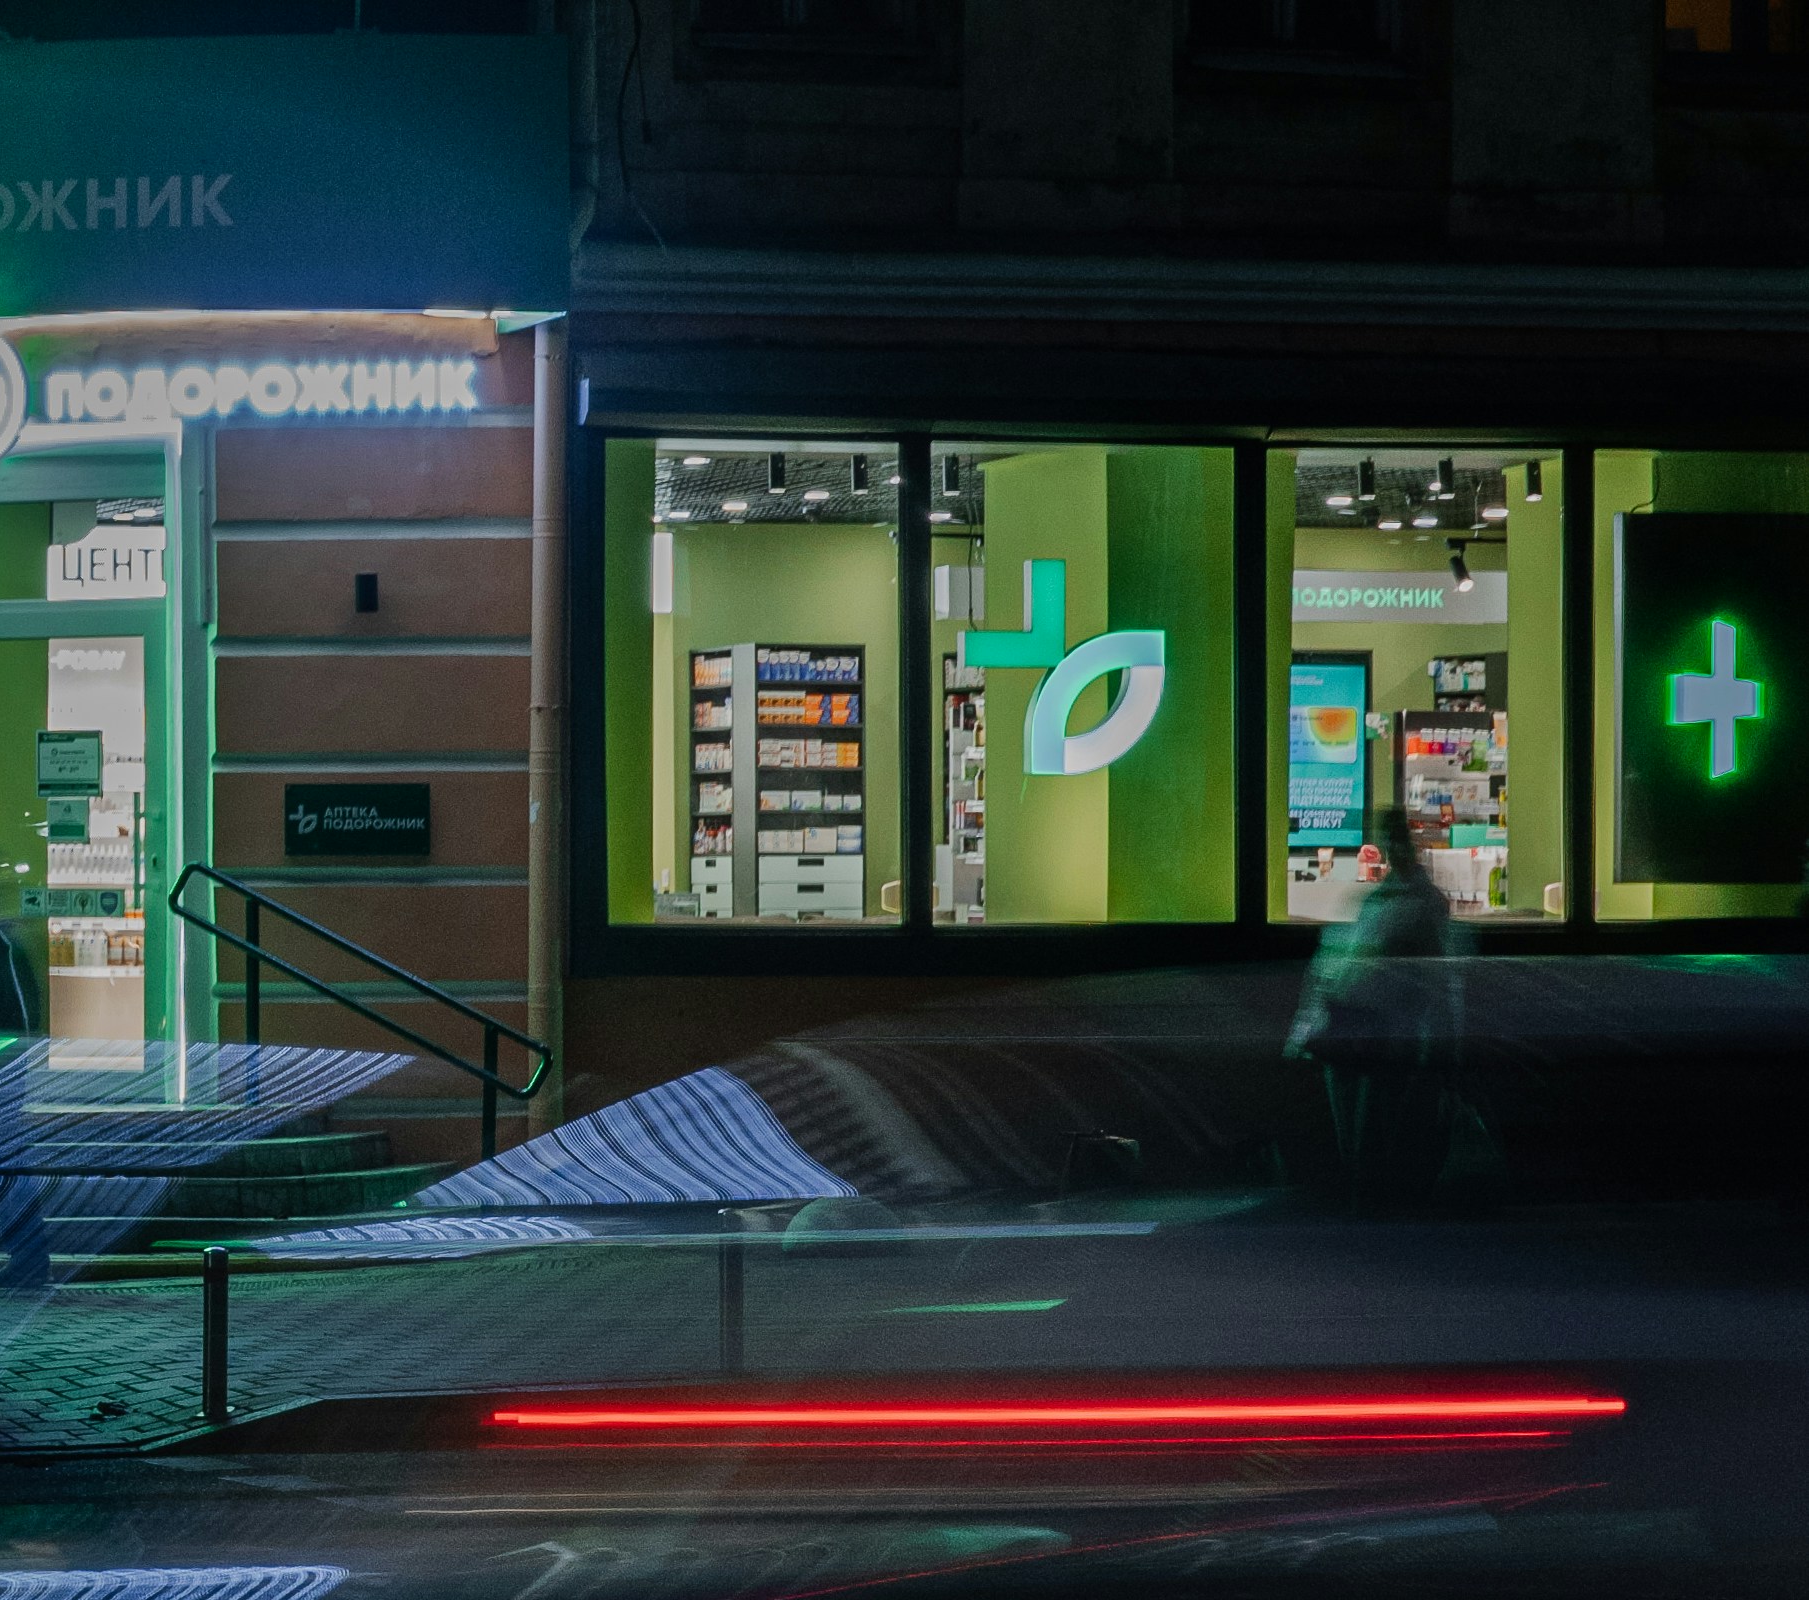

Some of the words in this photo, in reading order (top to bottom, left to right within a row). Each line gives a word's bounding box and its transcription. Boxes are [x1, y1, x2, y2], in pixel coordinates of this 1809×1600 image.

[49, 362, 475, 420] ПОДОРОЖНИК
[62, 548, 165, 588] ЦЕНТ
[323, 818, 426, 830] ПОДОРОЖНИК
[324, 806, 378, 818] АПТЕКА
